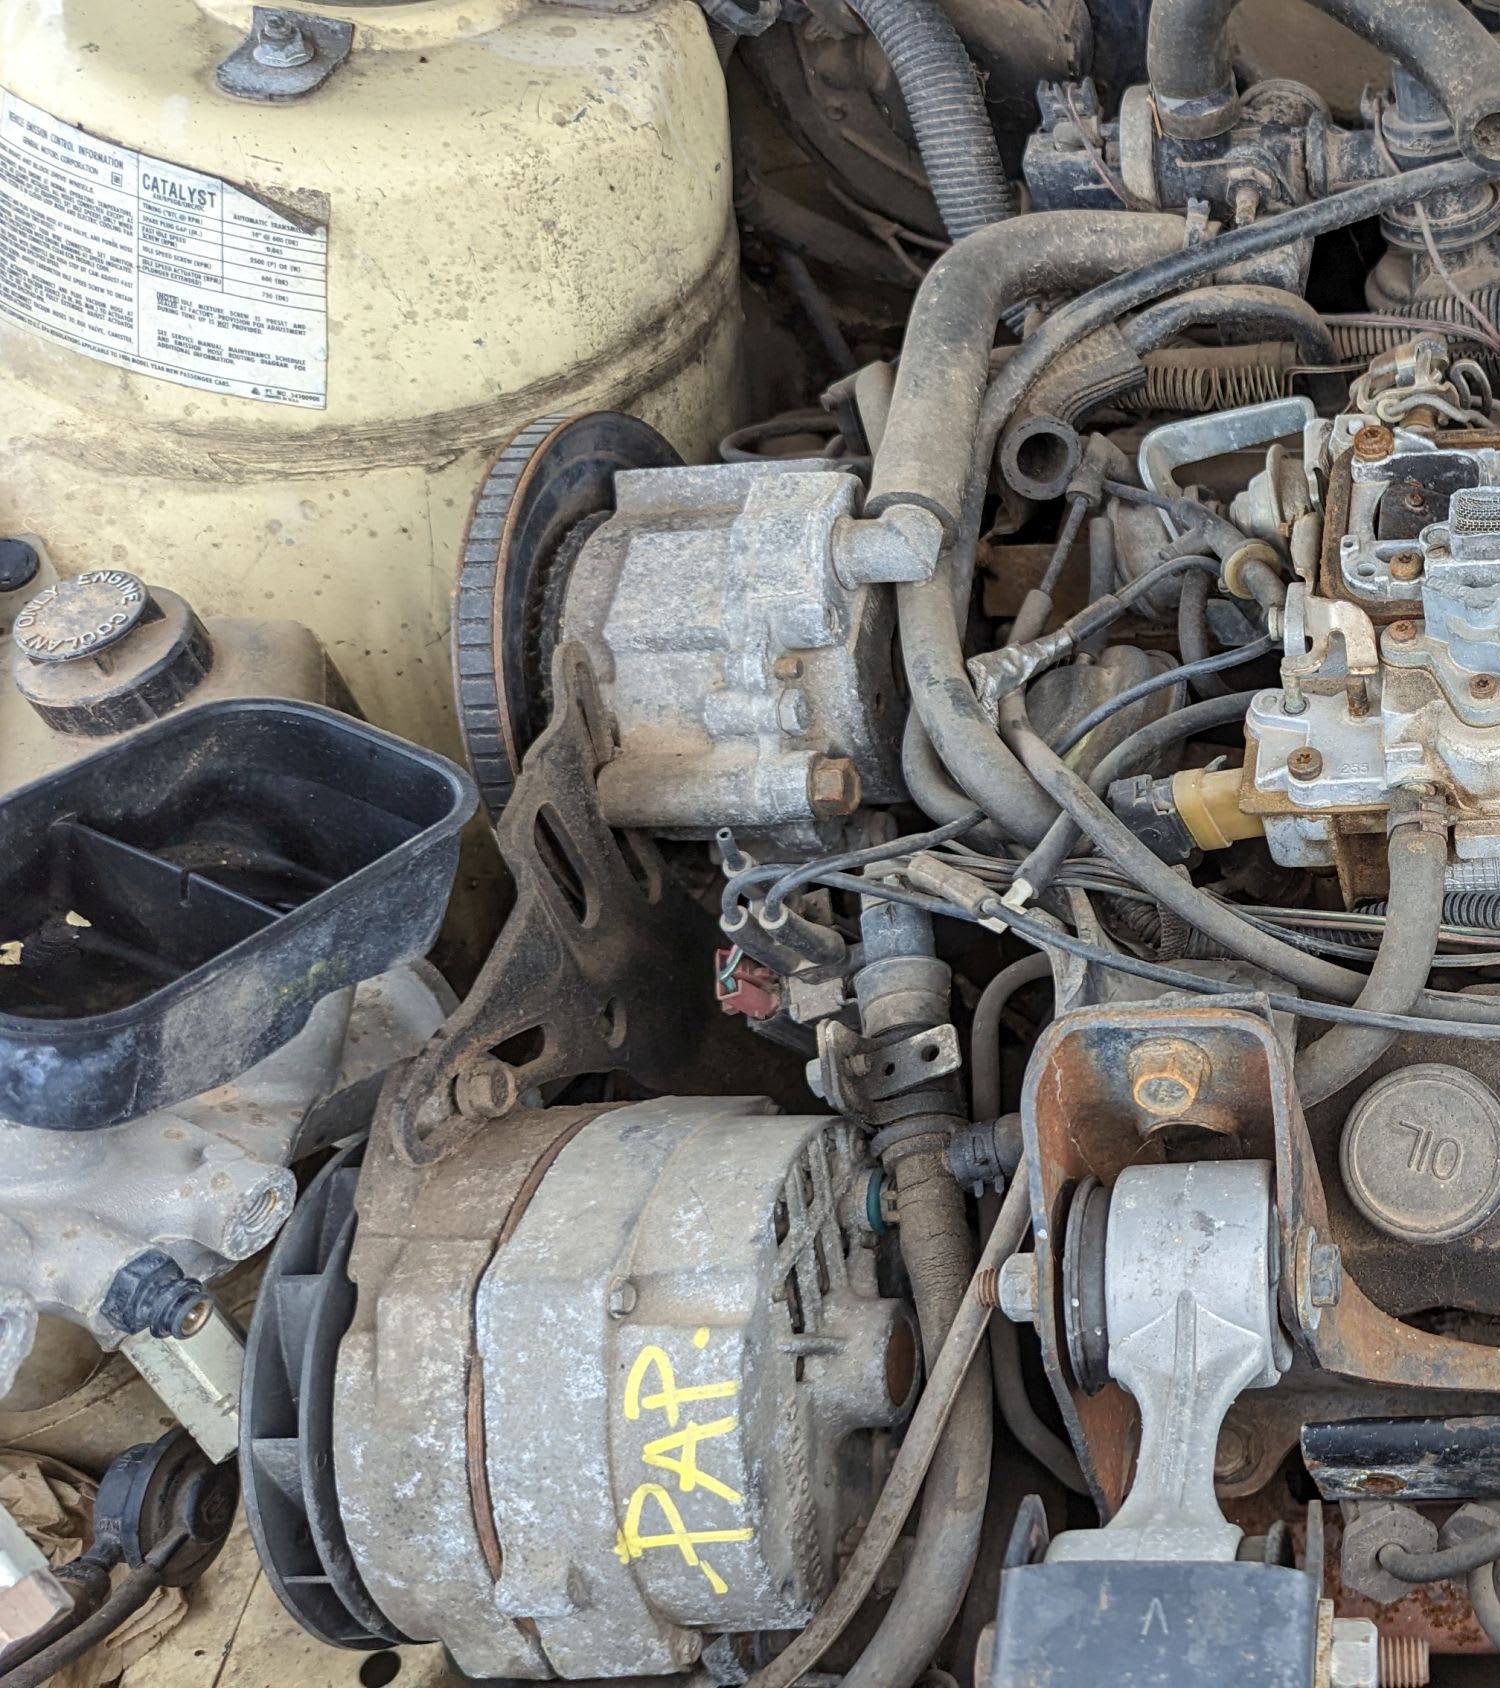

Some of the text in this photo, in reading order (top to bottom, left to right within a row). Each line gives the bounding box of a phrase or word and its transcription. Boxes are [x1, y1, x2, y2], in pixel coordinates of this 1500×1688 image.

[51, 133, 73, 151] CONTROL
[78, 145, 123, 170] INFORMATION
[61, 154, 97, 176] CORPORATION
[143, 173, 216, 208] CATALYST
[143, 203, 161, 213] TIMING
[233, 214, 266, 226] AUTOMATIC
[142, 226, 154, 234] FAST
[169, 235, 186, 244] SPEED
[142, 233, 159, 242] SCREW
[142, 246, 153, 254] IDLE
[155, 250, 172, 259] SPEED
[174, 255, 191, 264] SCREW
[155, 263, 172, 272] SPEED
[174, 268, 201, 279] ACTUATOR
[171, 274, 201, 286] EXTENDED)
[108, 311, 133, 322] ACTUATOR
[108, 317, 133, 329] ACTUATOR
[198, 304, 223, 314] MIXTURE
[230, 311, 248, 319] SCREW
[266, 318, 287, 326] PRESET
[218, 315, 250, 325] PROVISION
[266, 325, 305, 336] ADJUSTMENT
[232, 324, 263, 334] PROVIDED.
[157, 342, 234, 364] ADDITIONAL INFORMATION.
[172, 333, 193, 343] SERVICE
[228, 347, 270, 359] MAINTENANCE
[275, 356, 305, 365] SCHEDULE
[175, 341, 201, 351] EMISSION
[228, 353, 254, 362] ROUTING
[261, 359, 288, 368] DIAGRAM
[132, 358, 149, 367] MODEL
[180, 371, 212, 383] PASSENGER
[77, 570, 141, 605] ENGINE
[17, 584, 60, 631] ONLY
[22, 612, 129, 652] COOLANT
[1398, 1118, 1464, 1182] OIL
